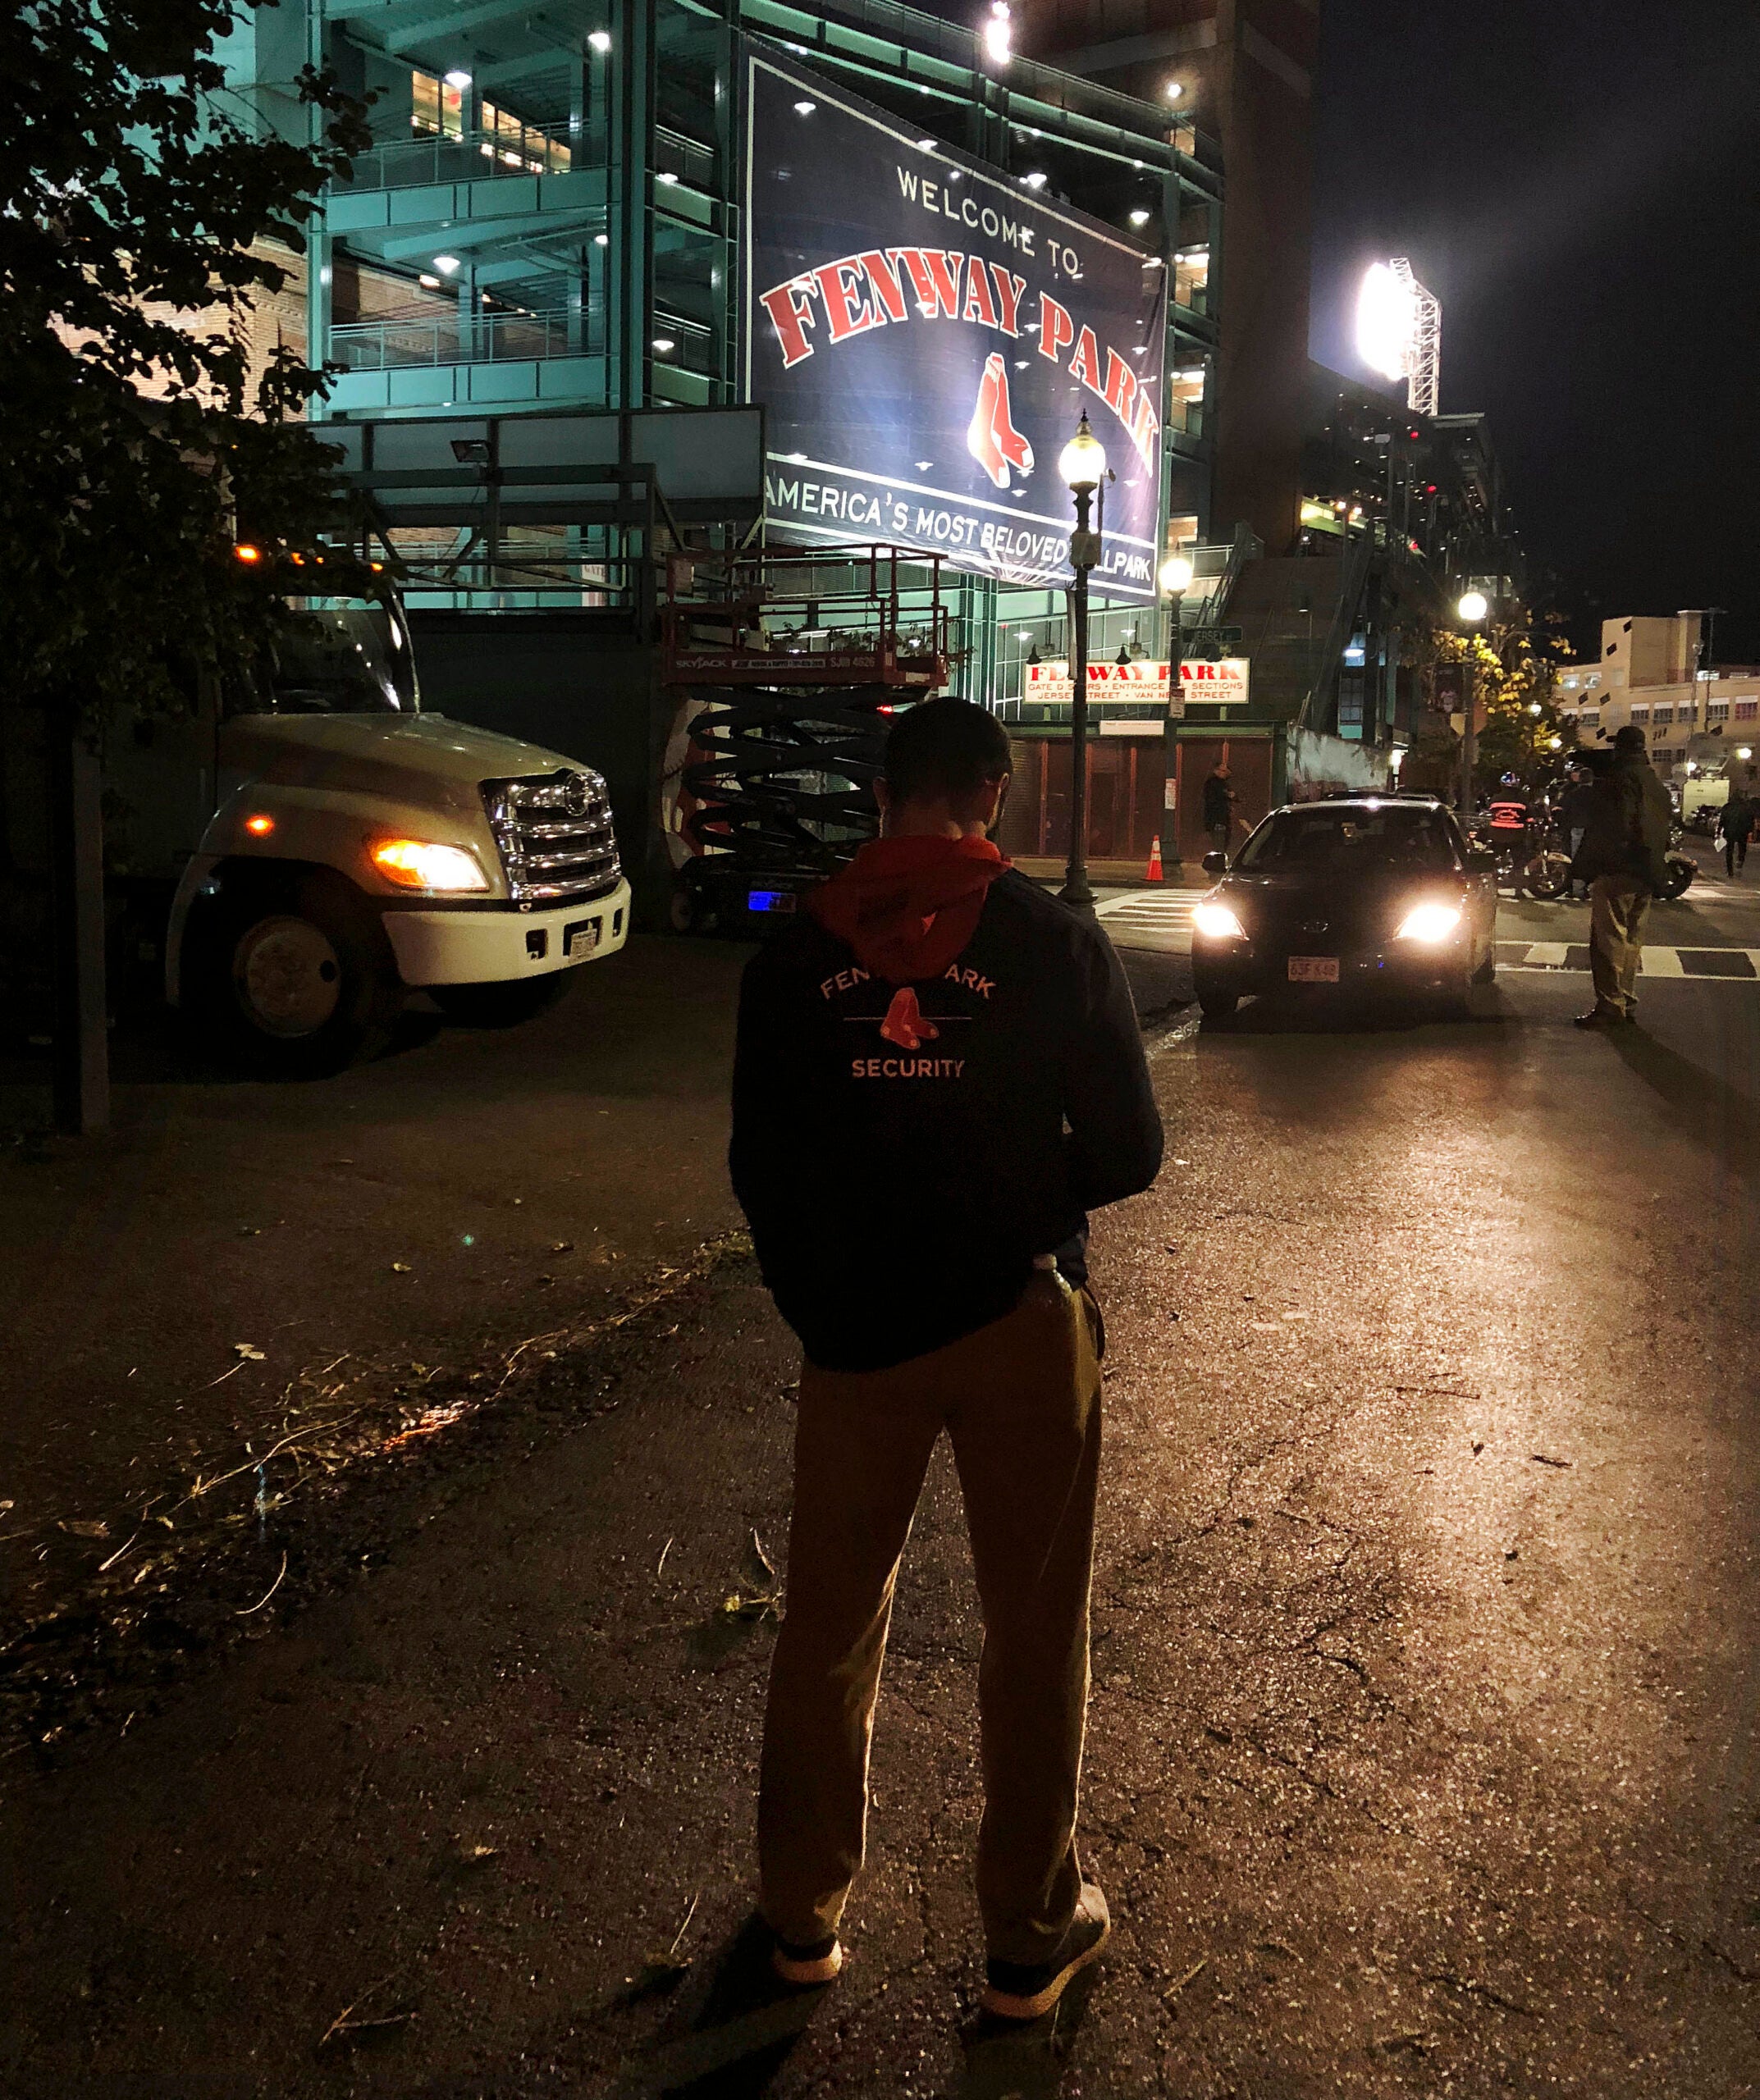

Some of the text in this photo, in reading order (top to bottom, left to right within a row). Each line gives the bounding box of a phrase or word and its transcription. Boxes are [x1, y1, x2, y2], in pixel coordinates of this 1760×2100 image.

[897, 166, 1078, 275] WELCOME TO
[759, 246, 1159, 477] FENWAY PARK
[766, 474, 909, 532] AMERICA'S
[916, 507, 979, 546] MOST
[981, 523, 1067, 564] BELOVED
[676, 656, 729, 669] SKYJACK
[1031, 666, 1144, 681] FEWAY
[1113, 682, 1165, 691] ENTRANCE
[1192, 682, 1243, 691] SECTIONS
[821, 963, 996, 1000] FEN ARK
[851, 1058, 966, 1079] SECURITY
